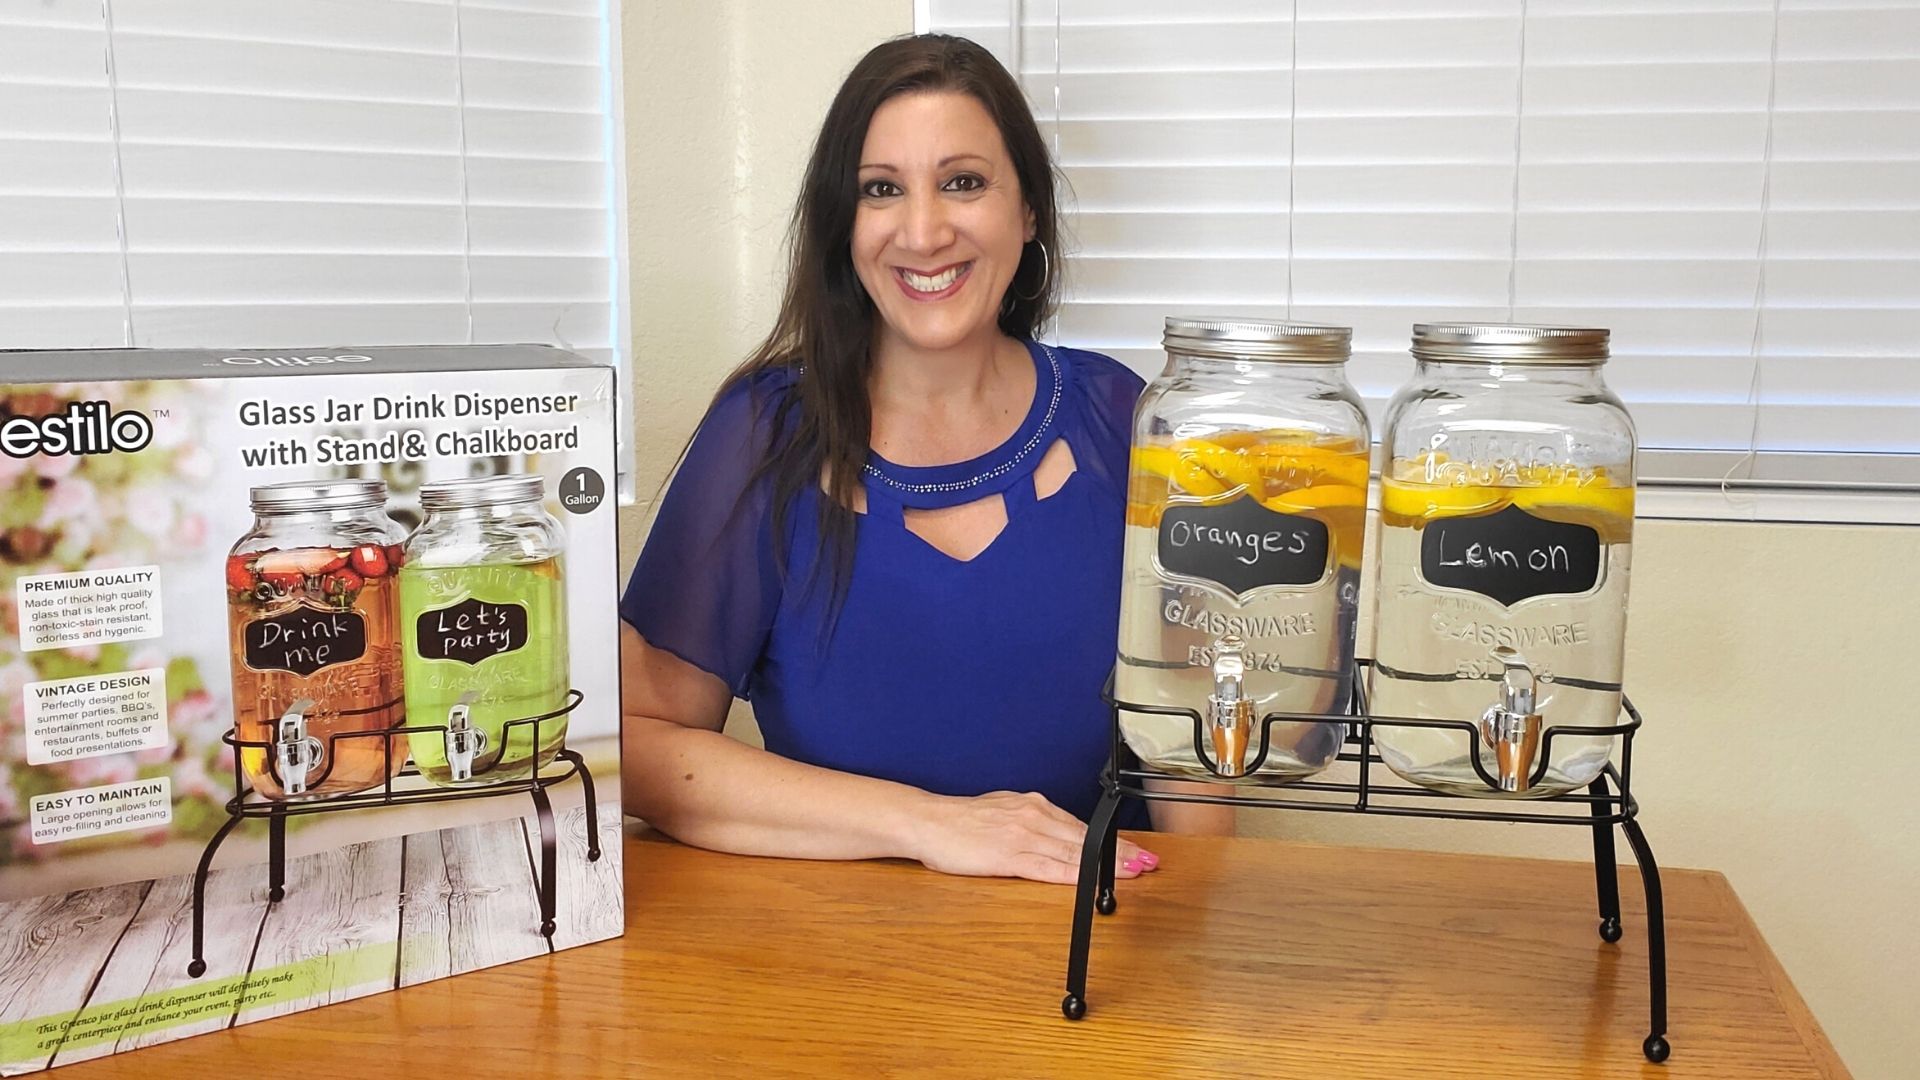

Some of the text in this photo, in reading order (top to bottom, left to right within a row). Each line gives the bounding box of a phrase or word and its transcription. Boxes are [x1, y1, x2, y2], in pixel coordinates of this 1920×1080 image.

[222, 355, 372, 367] estilo
[239, 392, 578, 426] Glass Jar Drink Dispenser
[0, 401, 153, 458] estilo
[242, 426, 578, 467] with Stand & Chalkboard
[576, 473, 585, 491] 1
[565, 494, 599, 505] Gallon
[1170, 520, 1309, 565] Oranges
[25, 572, 152, 592] PREMIUM QUALITY
[25, 589, 152, 608] Made of thick high quality
[32, 601, 147, 621] glass that is leak proof,
[438, 604, 508, 633] Let's
[1164, 599, 1317, 639] GLASSWARE
[29, 618, 103, 632] non-toxic-stain
[36, 626, 146, 644] odorless and hygenic.
[259, 614, 349, 649] Drink
[1431, 611, 1589, 647] GLASSWARE
[443, 628, 510, 656] party
[285, 643, 330, 668] me
[36, 675, 150, 698] VINTAGE DESIGN
[42, 690, 150, 711] Perfectly designed for
[34, 712, 159, 736] entertainment rooms and
[37, 713, 78, 723] summer
[106, 726, 139, 738] buffets
[51, 739, 146, 757] food presentations.
[36, 784, 162, 812] EASY TO MAINTAIN
[41, 799, 162, 825] Large opening allows for
[35, 829, 59, 838] easy
[62, 820, 101, 834] re-filling
[104, 817, 123, 826] and
[36, 972, 294, 1034] This Greenco jar glass drink dispenser will definitely make
[45, 1035, 69, 1049] great
[72, 1023, 123, 1039] centerpiece
[124, 1015, 144, 1029] and
[144, 1011, 180, 1027] enhance
[183, 1007, 206, 1019] your
[234, 994, 257, 1008] party
